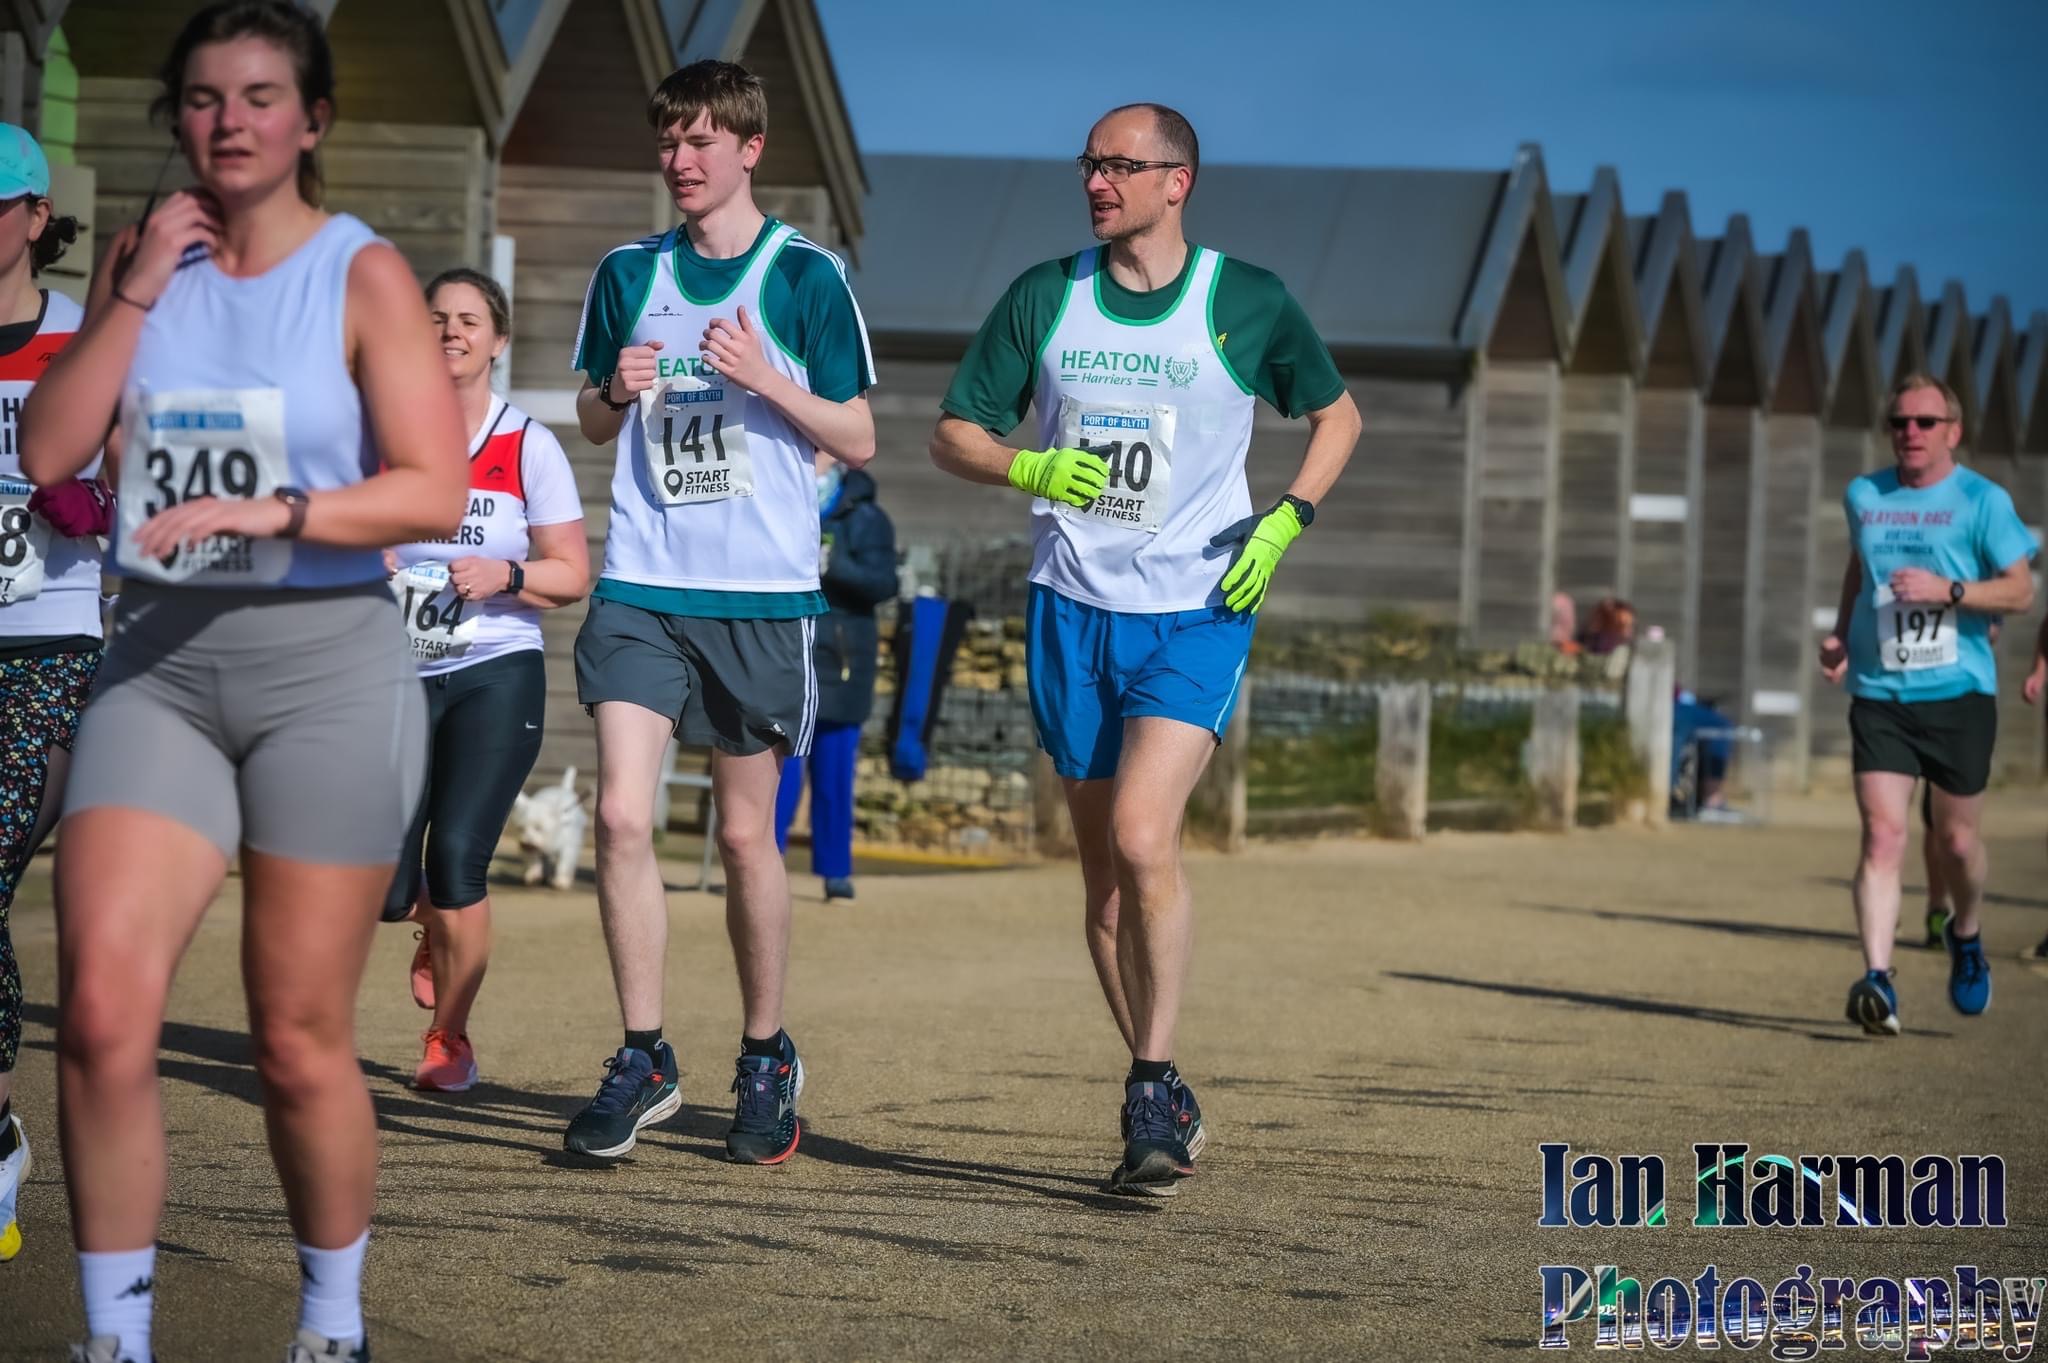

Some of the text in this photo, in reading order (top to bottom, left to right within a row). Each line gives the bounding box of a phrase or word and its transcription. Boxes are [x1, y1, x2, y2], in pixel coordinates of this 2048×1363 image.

[659, 358, 720, 377] EATO
[1061, 350, 1161, 375] HEATON
[1081, 373, 1133, 386] Harriers
[665, 390, 722, 404] PORT OF BLYTH
[1083, 415, 1148, 429] PORT OF BLYTH
[663, 414, 726, 466] 141
[1080, 437, 1153, 492] 40
[146, 447, 258, 518] 349
[686, 469, 730, 485] START
[685, 482, 730, 496] FITNESS
[1097, 495, 1145, 511] START
[1094, 507, 1142, 522] FITNESS
[404, 586, 463, 635] 164
[1895, 609, 1945, 643] 197
[413, 637, 451, 652] START
